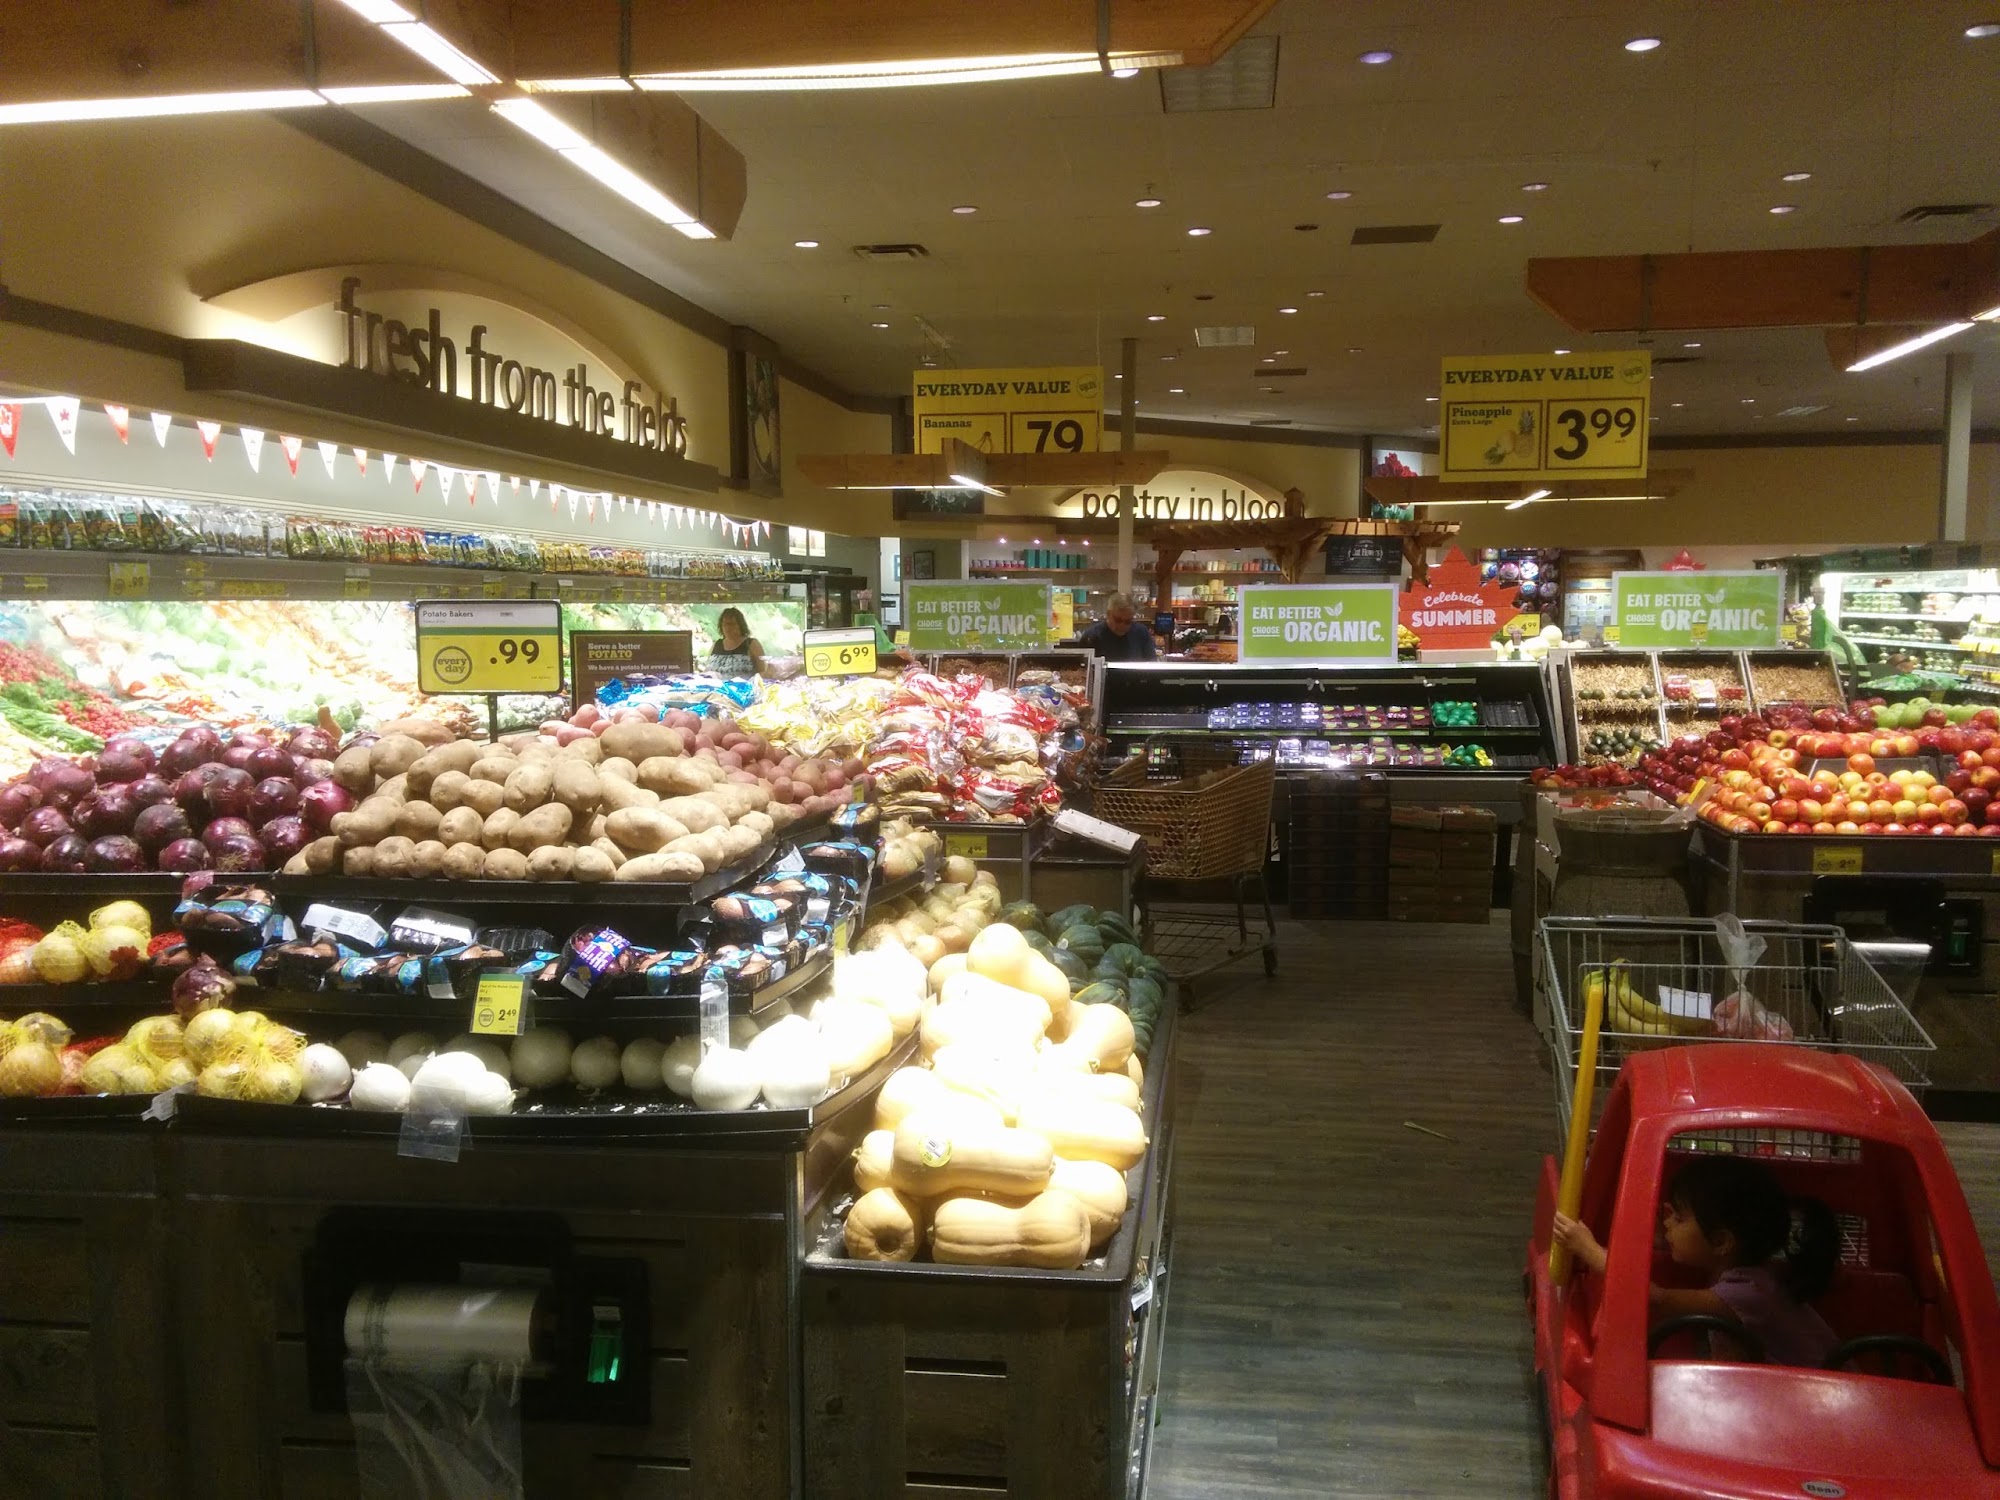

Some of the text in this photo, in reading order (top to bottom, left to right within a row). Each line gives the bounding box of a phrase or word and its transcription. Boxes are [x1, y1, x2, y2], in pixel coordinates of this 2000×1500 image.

[334, 277, 688, 459] fresh from the fields
[1445, 368, 1546, 384] EVERYDAY
[1550, 366, 1615, 381] VALUE
[917, 382, 1009, 397] EVERYDAY
[1012, 381, 1071, 395] VALUE
[1452, 406, 1513, 418] Pineapple
[924, 419, 972, 429] Bananas
[1027, 419, 1084, 454] 79
[1083, 489, 1180, 520] potry
[1189, 487, 1213, 520] in
[1423, 591, 1484, 608] Celebrate
[1627, 593, 1701, 607] EAT BETTER
[423, 610, 474, 618] Potato Bakers
[917, 601, 981, 613] EAT BETTER
[1252, 606, 1322, 620] EAT BETTER
[917, 620, 943, 628] CHOOSE
[1411, 609, 1497, 628] SUMMER
[1626, 614, 1656, 623] CHOOSE
[1252, 620, 1385, 643] CHOOSE ORGANIC.
[489, 638, 540, 665] .99
[618, 642, 641, 650] better
[437, 657, 467, 666] every
[588, 650, 633, 659] POTATO
[445, 664, 465, 674] day
